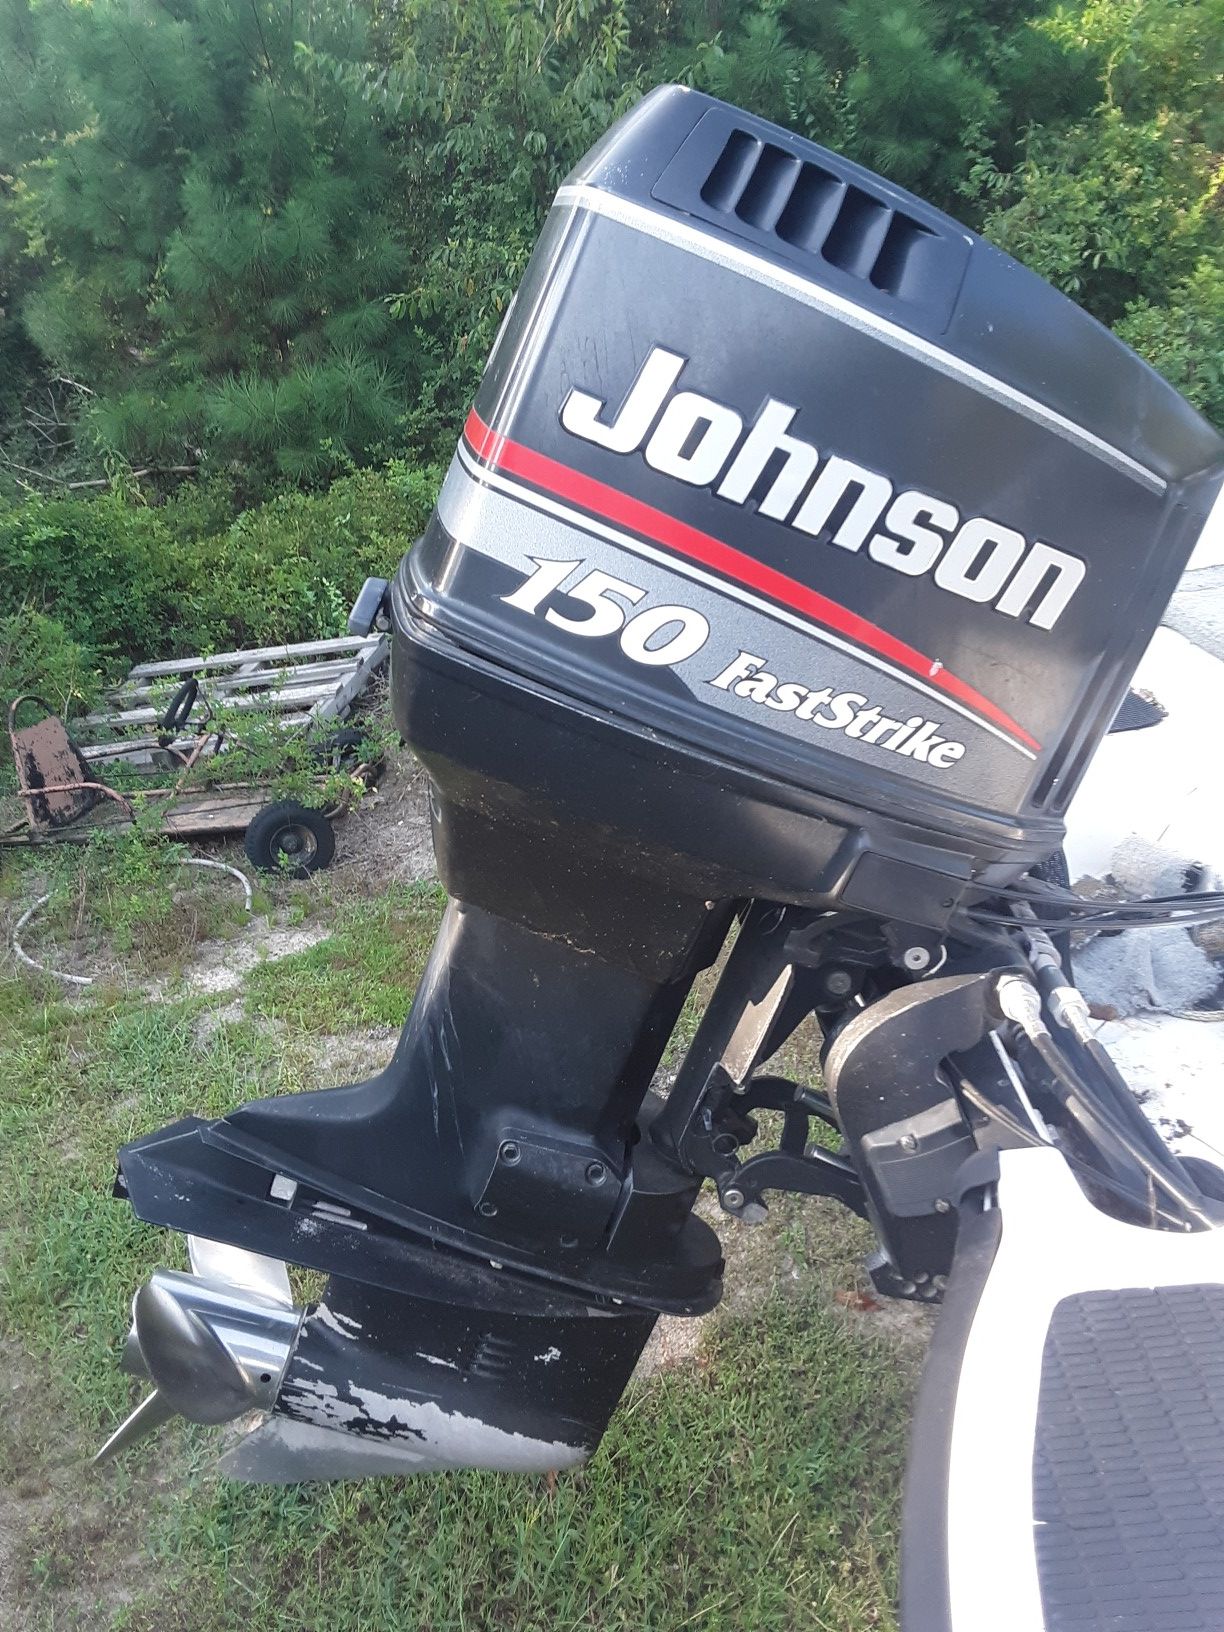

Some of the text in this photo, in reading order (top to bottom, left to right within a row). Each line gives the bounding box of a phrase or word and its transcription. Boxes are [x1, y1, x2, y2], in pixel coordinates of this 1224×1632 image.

[561, 346, 1086, 630] Johnson
[501, 556, 966, 769] 150 FastStrike
